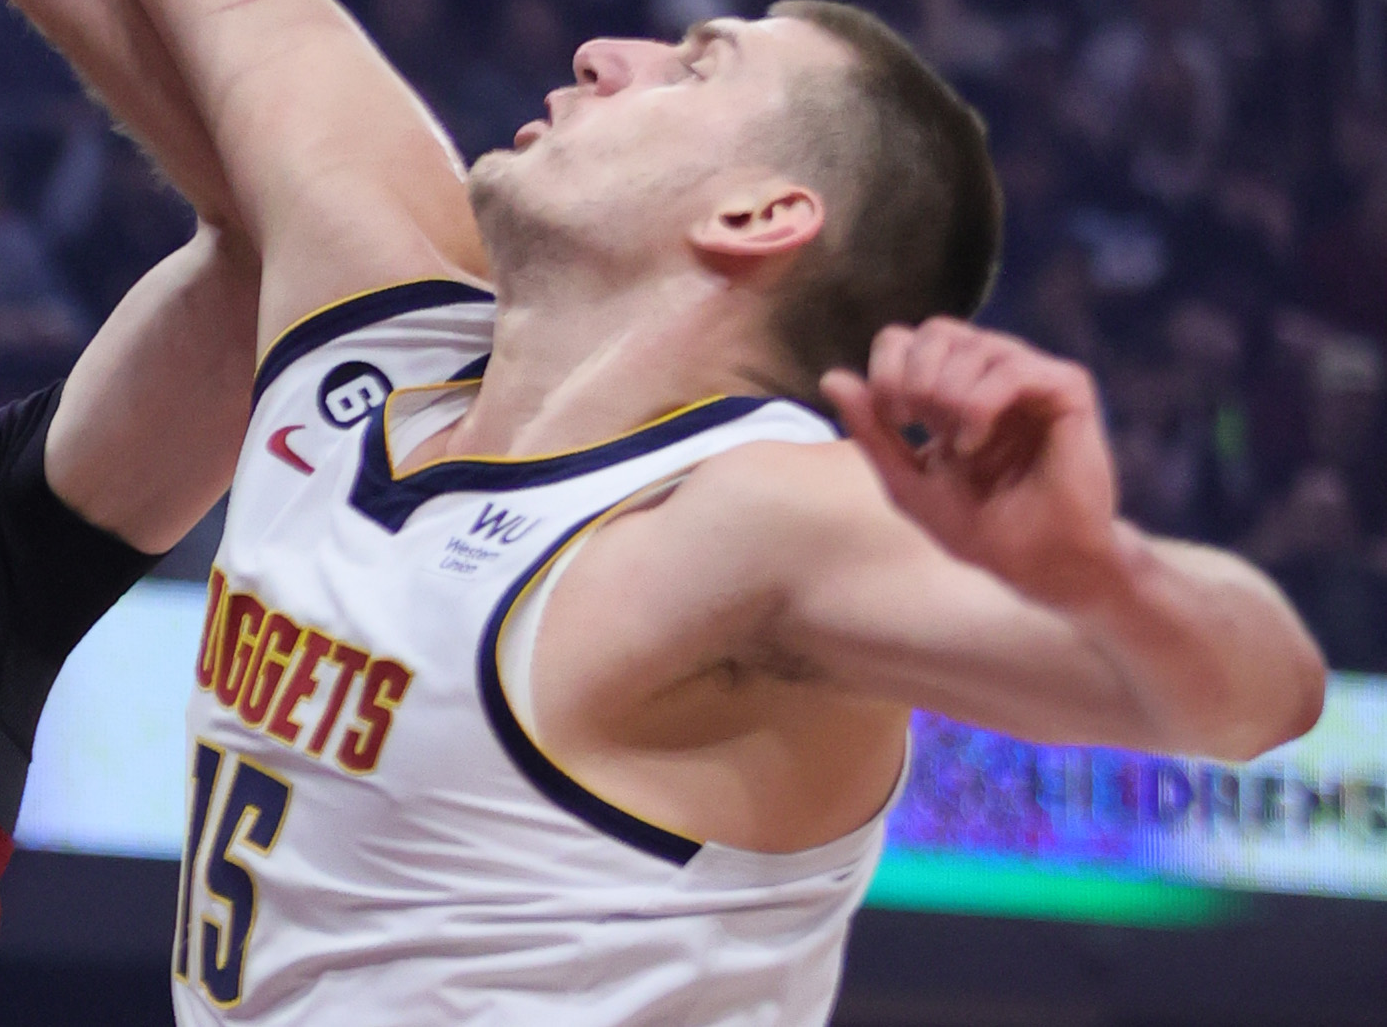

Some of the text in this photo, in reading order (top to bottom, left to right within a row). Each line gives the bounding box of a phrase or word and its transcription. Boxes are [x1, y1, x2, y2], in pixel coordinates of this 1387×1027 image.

[325, 374, 384, 423] 6
[469, 502, 543, 544] WU
[439, 555, 478, 574] Union
[445, 536, 502, 560] Western
[196, 563, 415, 775] UGGETS
[175, 735, 294, 1010] 15
